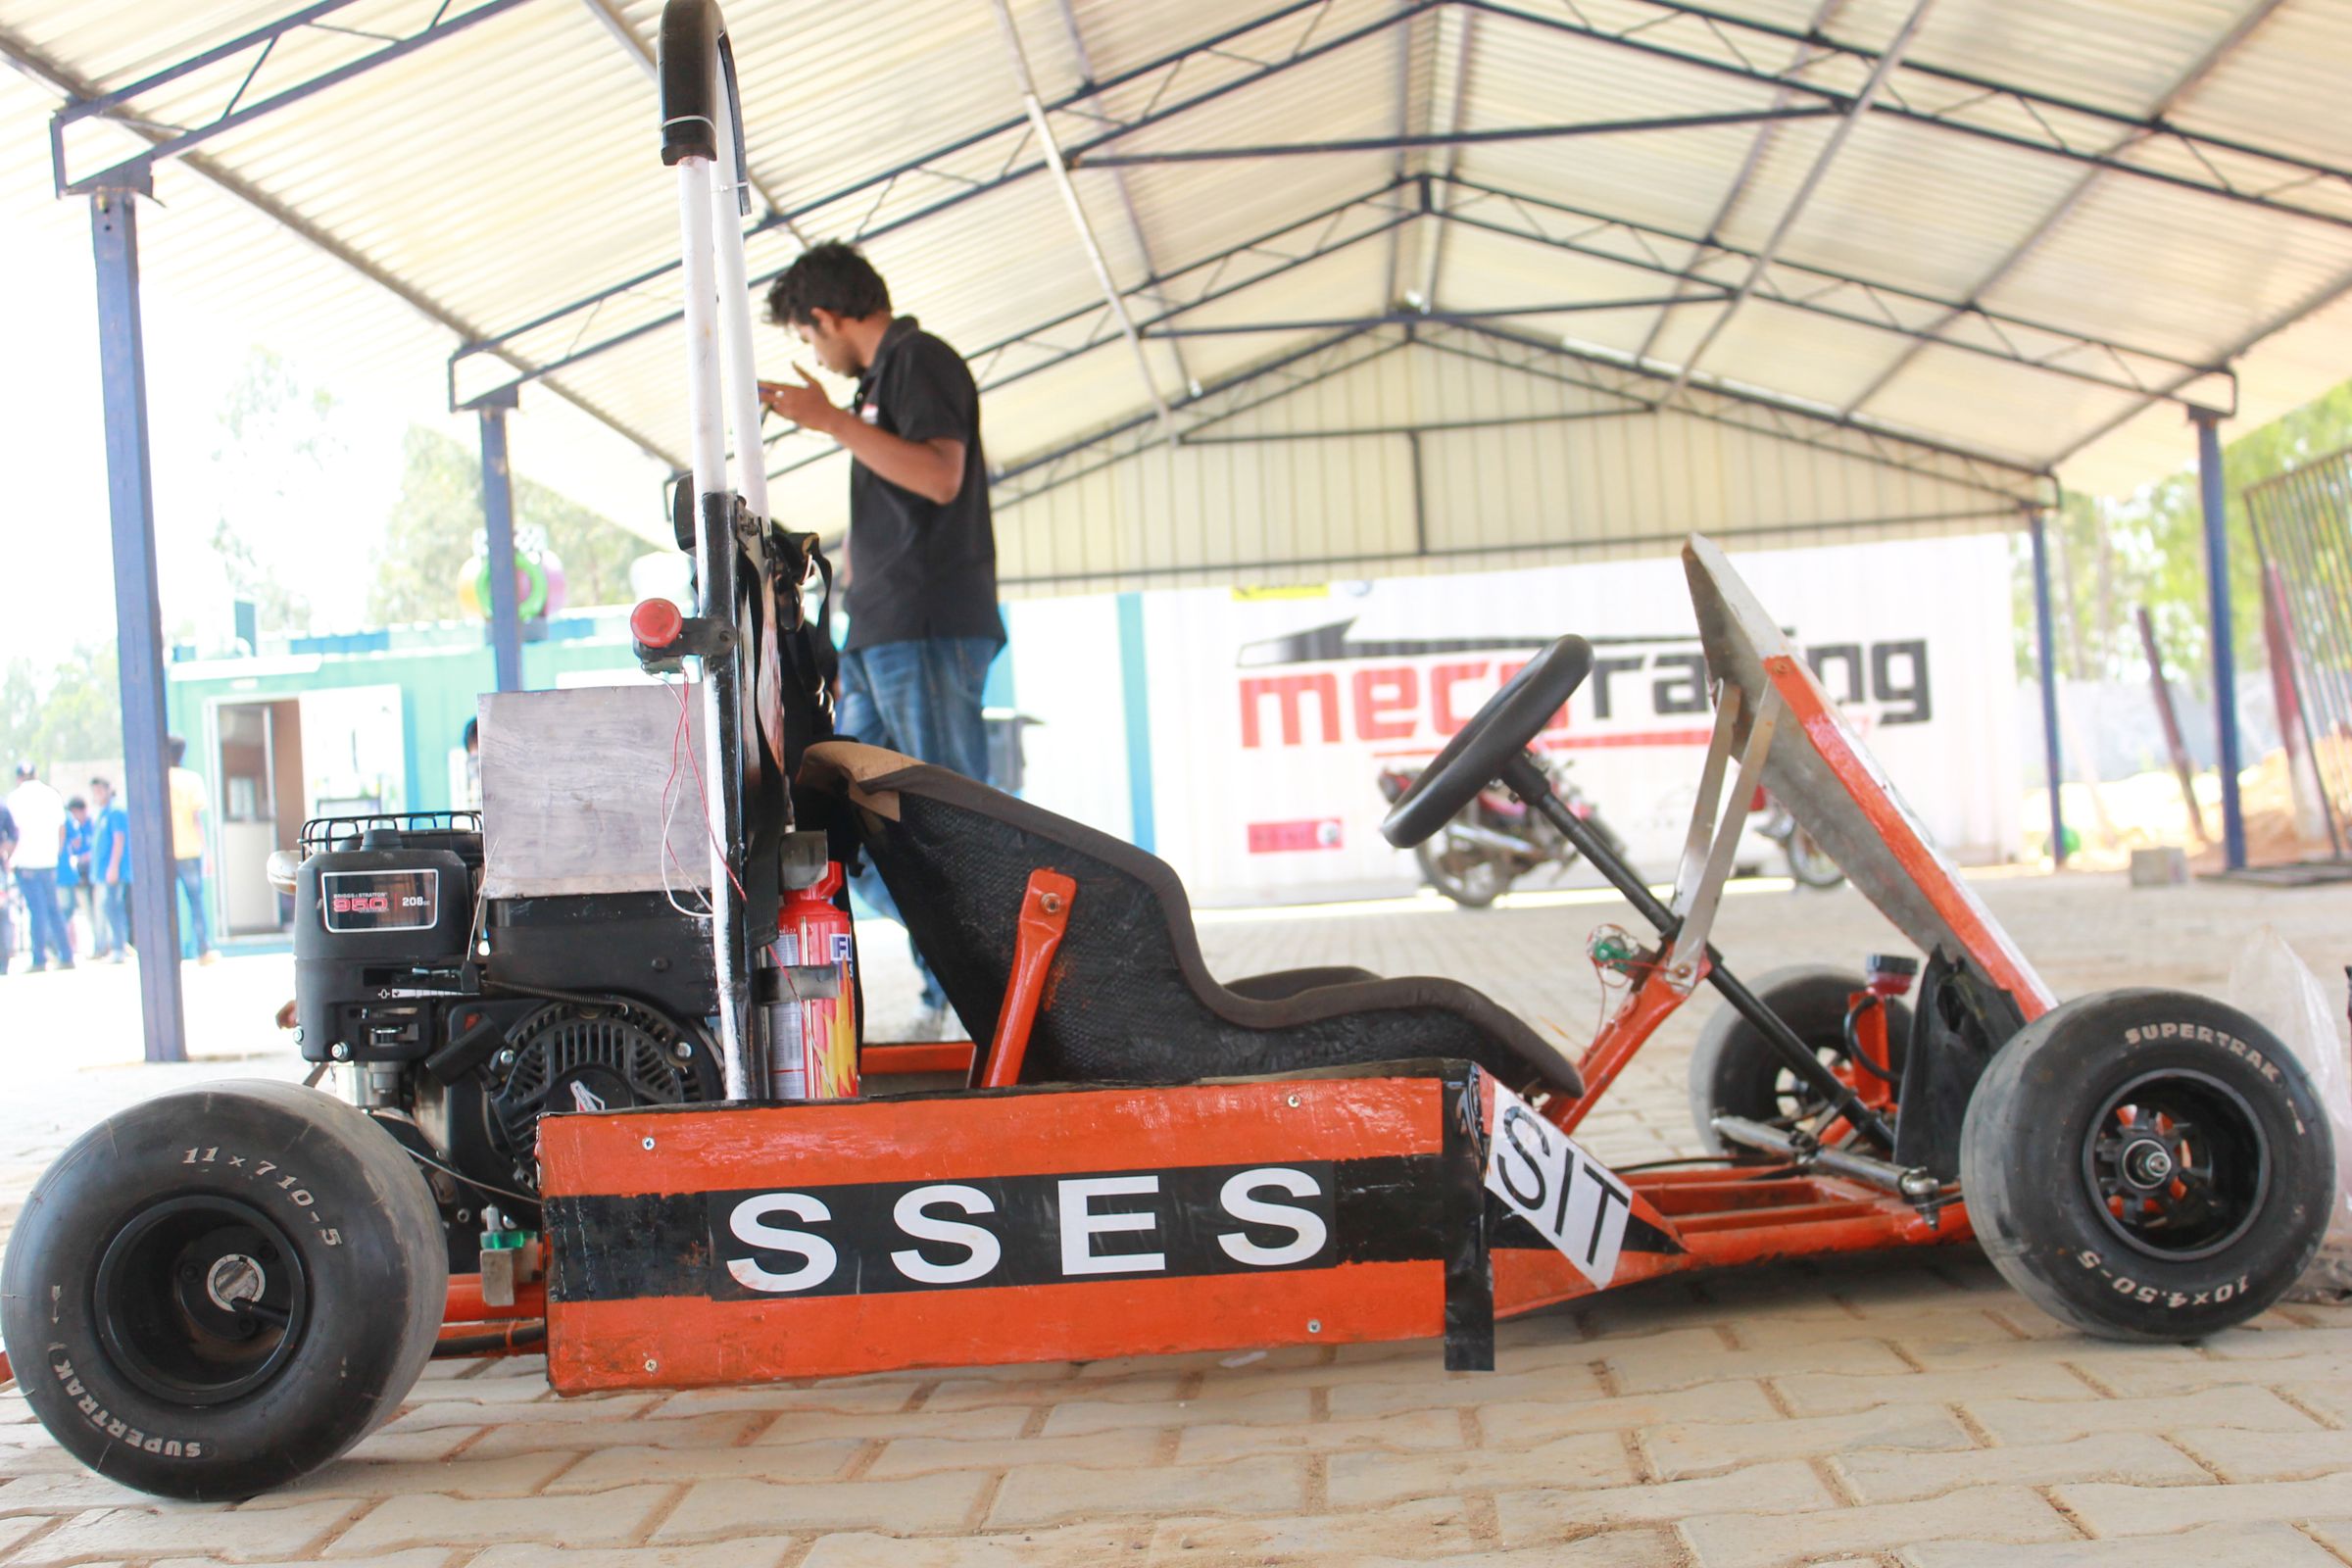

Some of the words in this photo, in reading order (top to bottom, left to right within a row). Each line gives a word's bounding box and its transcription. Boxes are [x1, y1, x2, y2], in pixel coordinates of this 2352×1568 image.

[333, 897, 388, 912] 950
[2125, 1022, 2280, 1083] SUPERTRAK
[1496, 1105, 1630, 1266] SIT
[54, 1358, 201, 1458] SUPERTRAK
